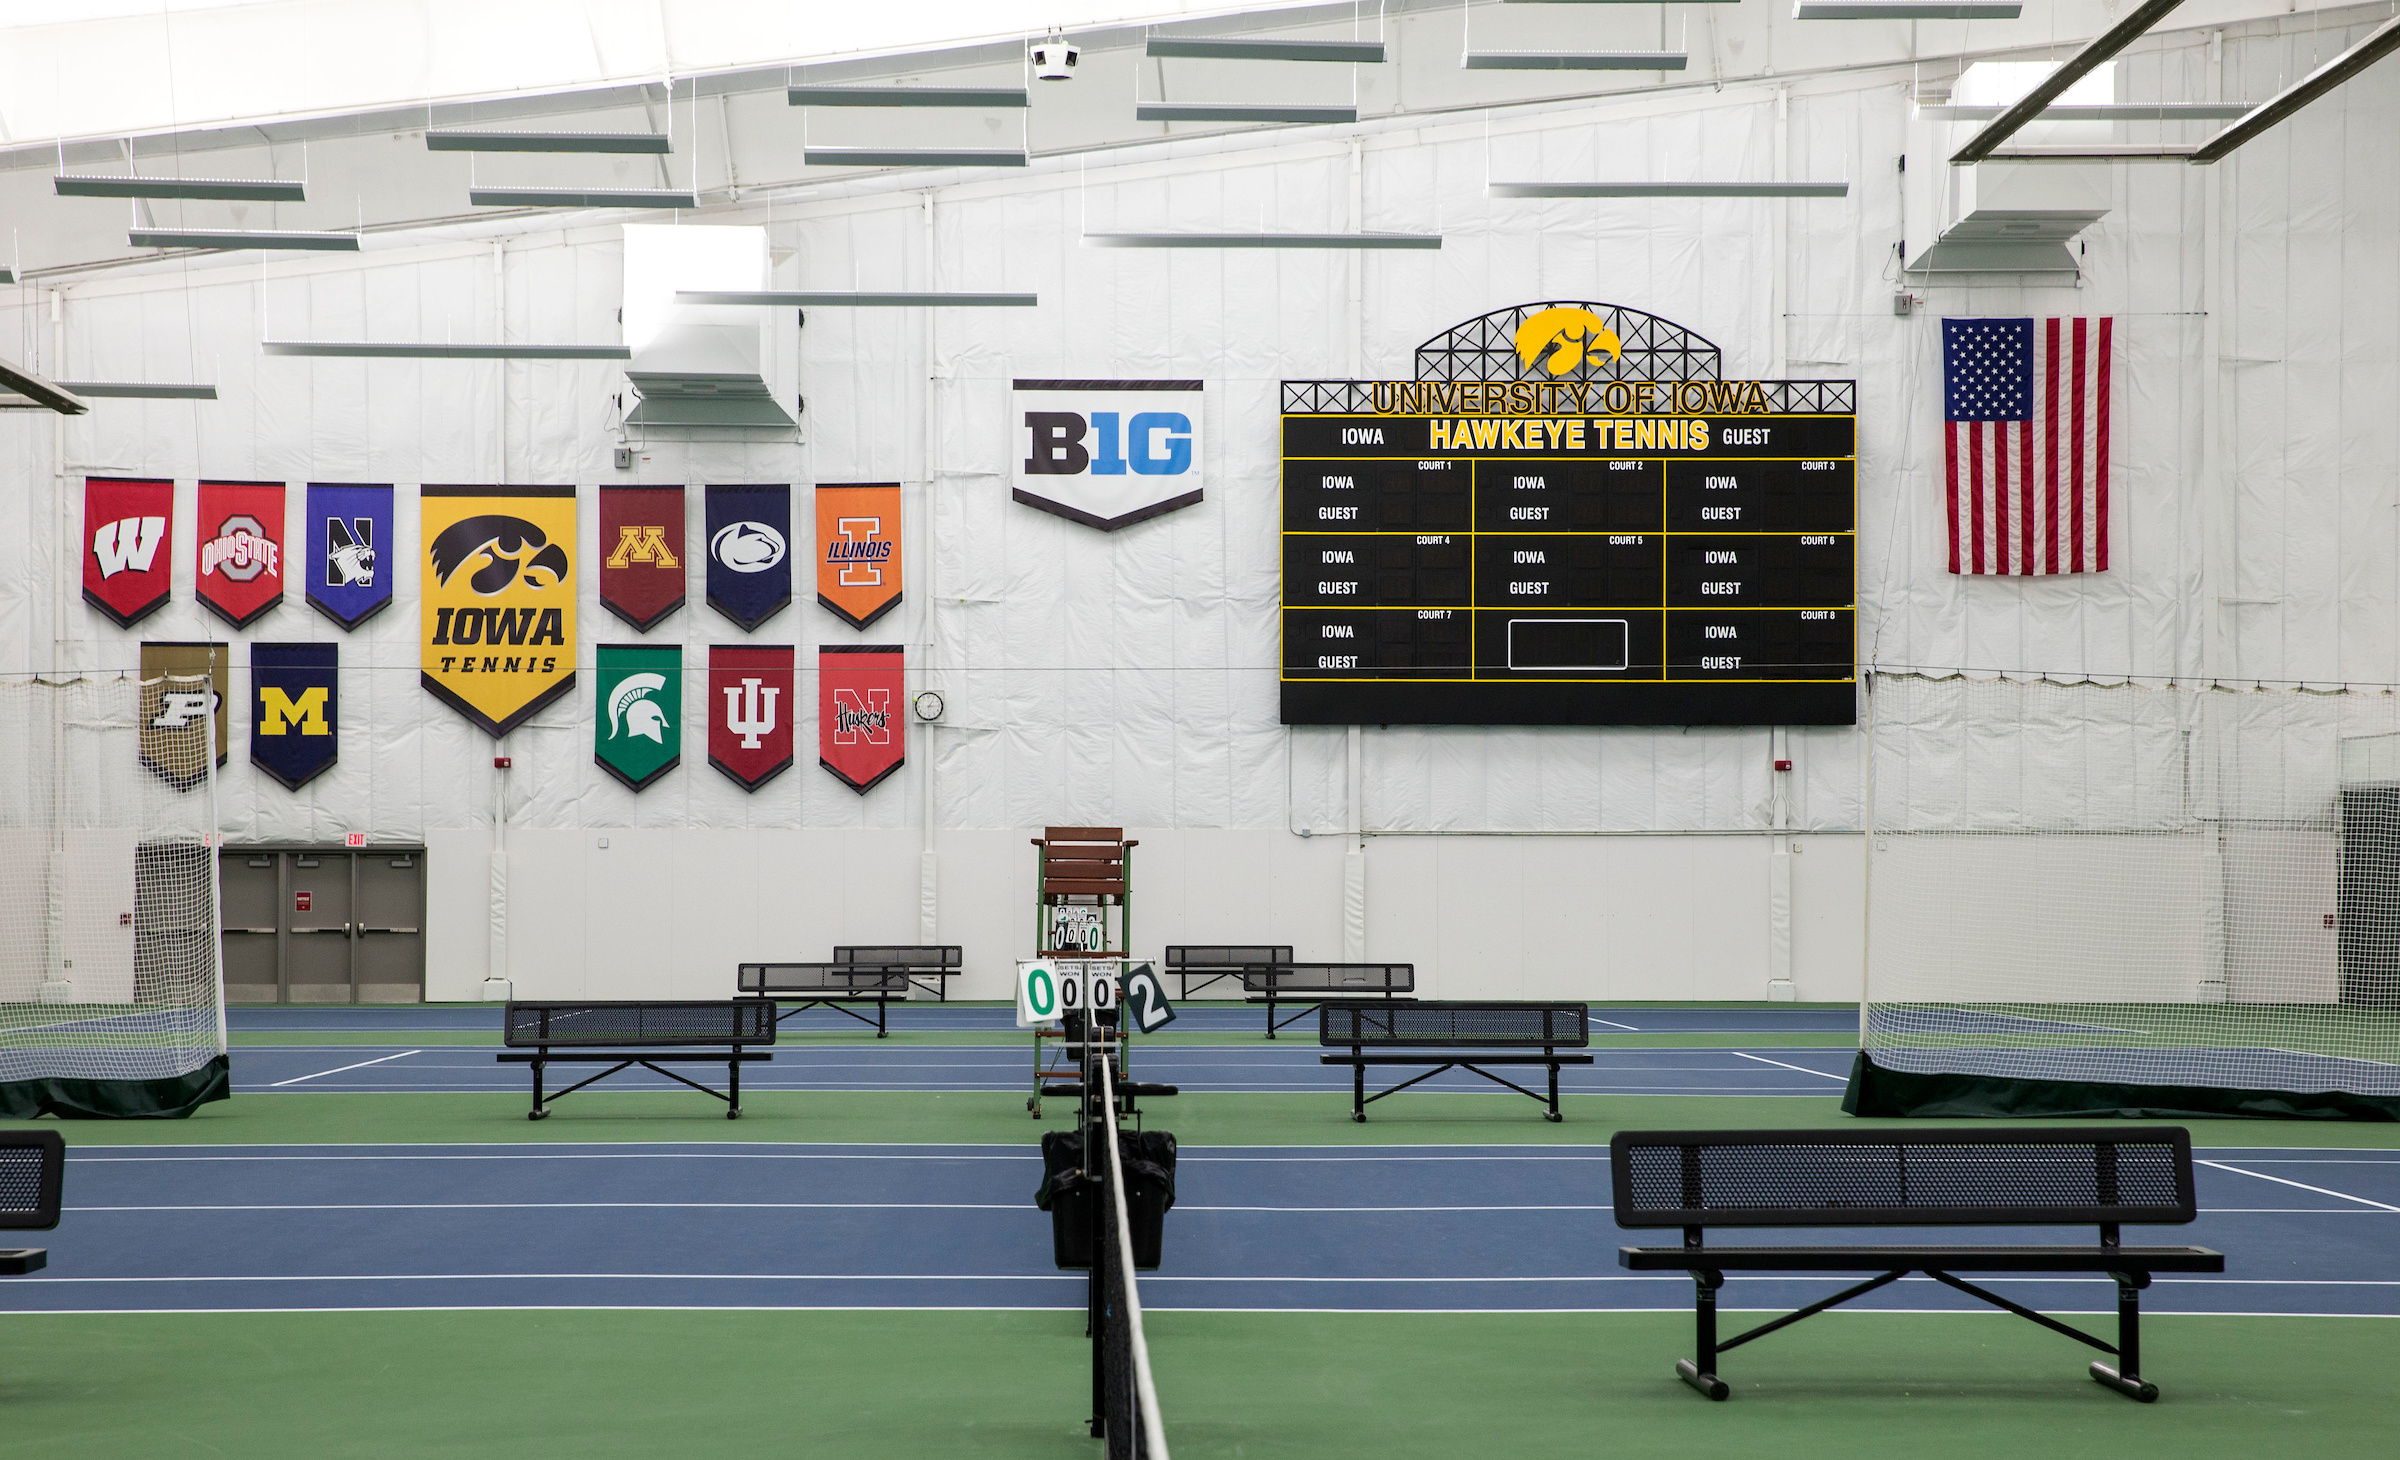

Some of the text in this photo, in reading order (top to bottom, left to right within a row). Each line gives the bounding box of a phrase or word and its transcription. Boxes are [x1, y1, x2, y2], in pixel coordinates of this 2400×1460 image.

[1371, 381, 1770, 415] UNIVERSITY OF IOWA
[1342, 428, 1385, 445] IOWA
[1430, 419, 1710, 451] HAWKEYE TENNIS
[1722, 428, 1771, 445] GUEST
[1417, 460, 1451, 470] COURT 1
[1609, 460, 1643, 470] COURT 2
[1802, 460, 1836, 470] COURT 3
[1323, 476, 1355, 489] IOWA
[1514, 476, 1546, 489] IOWA
[1706, 476, 1738, 489] IOWA
[1319, 507, 1359, 521] GUEST
[1510, 507, 1550, 521] GUEST
[1702, 507, 1742, 521] GUEST
[1417, 535, 1451, 545] COURT 4
[1609, 535, 1643, 545] COURT 5
[1801, 535, 1835, 545] COURT 6
[93, 516, 166, 581] W
[202, 531, 278, 578] OHIO STATE
[606, 526, 679, 569] M
[827, 541, 892, 558] ILLINOIS
[1323, 550, 1355, 563] IOWA
[1514, 550, 1546, 563] IOWA
[1706, 550, 1738, 563] IOWA
[1319, 581, 1359, 595] GUEST
[1510, 581, 1550, 595] GUEST
[1702, 581, 1742, 595] GUEST
[1418, 610, 1452, 620] COURT 7
[1801, 610, 1835, 620] COURT 8
[432, 607, 565, 645] IOWA
[1323, 625, 1355, 638] IOWA
[1706, 625, 1738, 638] IOWA
[441, 657, 556, 673] TENNIS
[1319, 656, 1359, 670] GUEST
[1702, 656, 1742, 670] GUEST
[260, 687, 328, 735] M
[835, 701, 890, 735] Huskers
[348, 833, 364, 845] EXIT
[1090, 927, 1098, 950] 0
[1028, 969, 1055, 1016] 0
[1062, 978, 1077, 1007] 0
[1094, 978, 1109, 1008] 0
[1129, 974, 1168, 1029] 2
